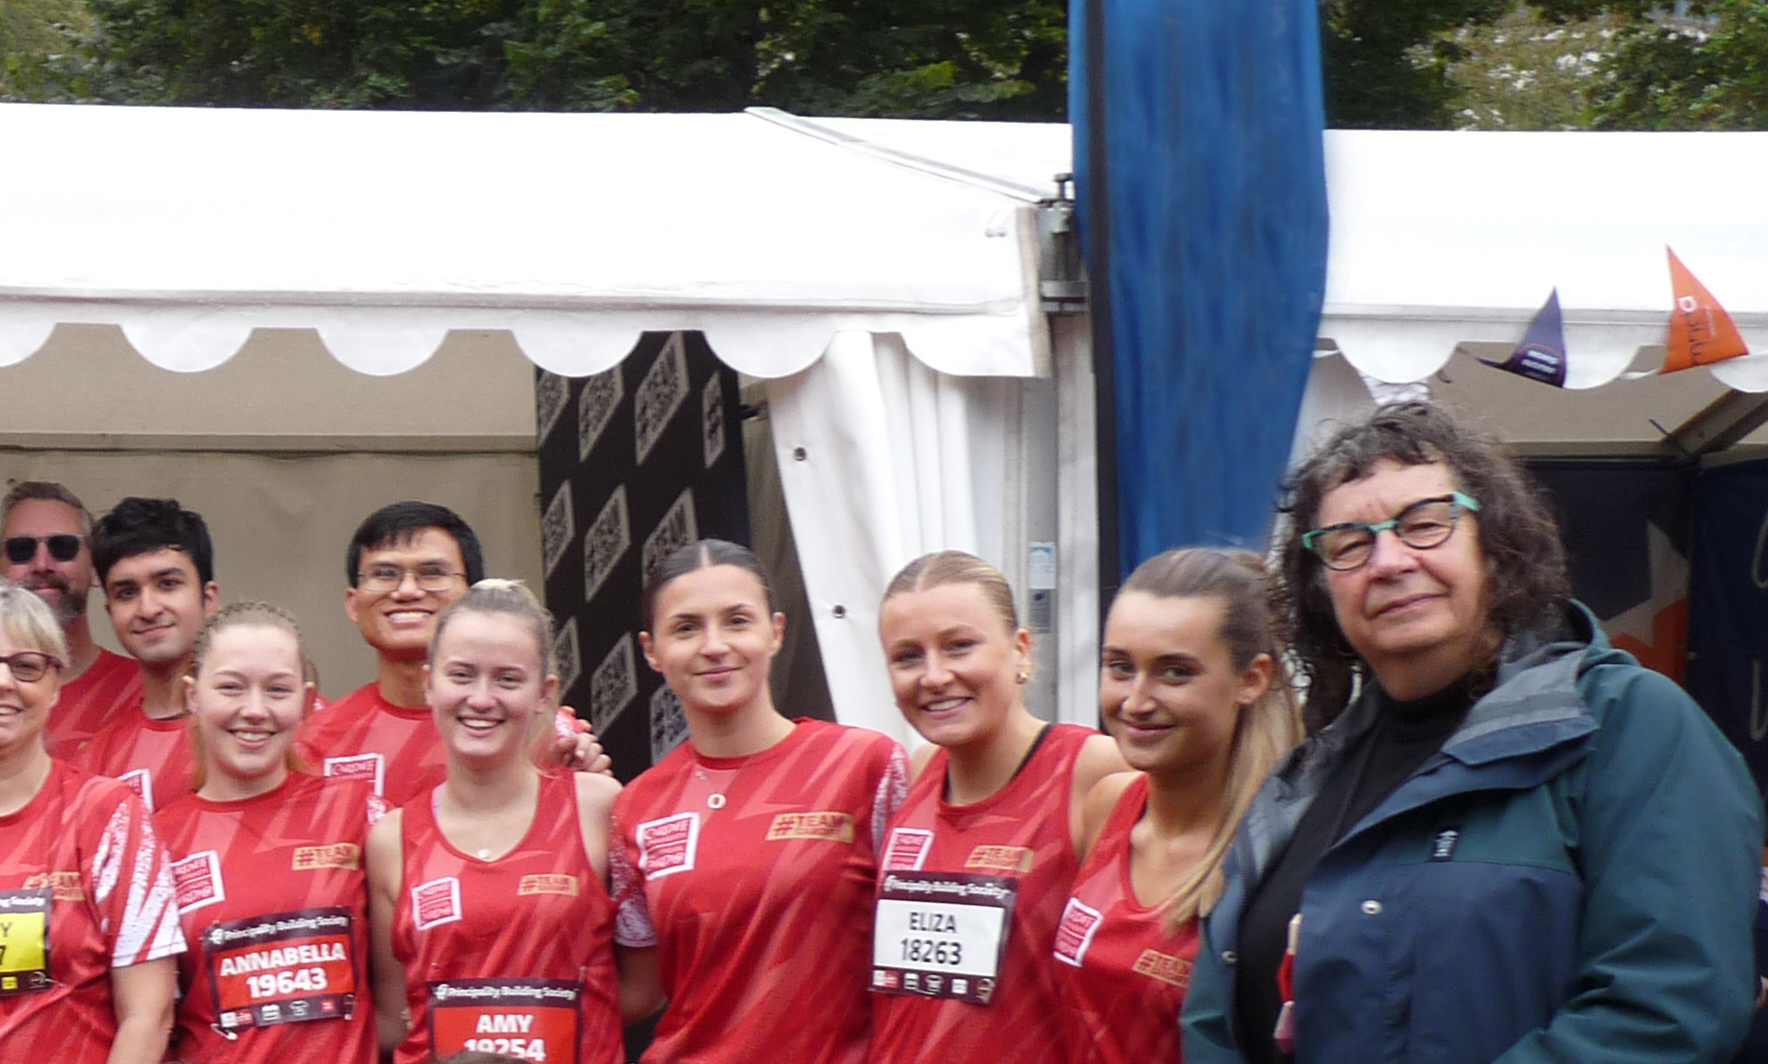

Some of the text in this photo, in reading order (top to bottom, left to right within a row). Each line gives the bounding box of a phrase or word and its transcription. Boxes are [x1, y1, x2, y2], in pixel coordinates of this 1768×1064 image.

[908, 911, 957, 934] ELIZA
[219, 941, 347, 977] ANNABELLA
[900, 937, 963, 966] 18263
[245, 966, 329, 999] 19643
[475, 1014, 534, 1034] AMY
